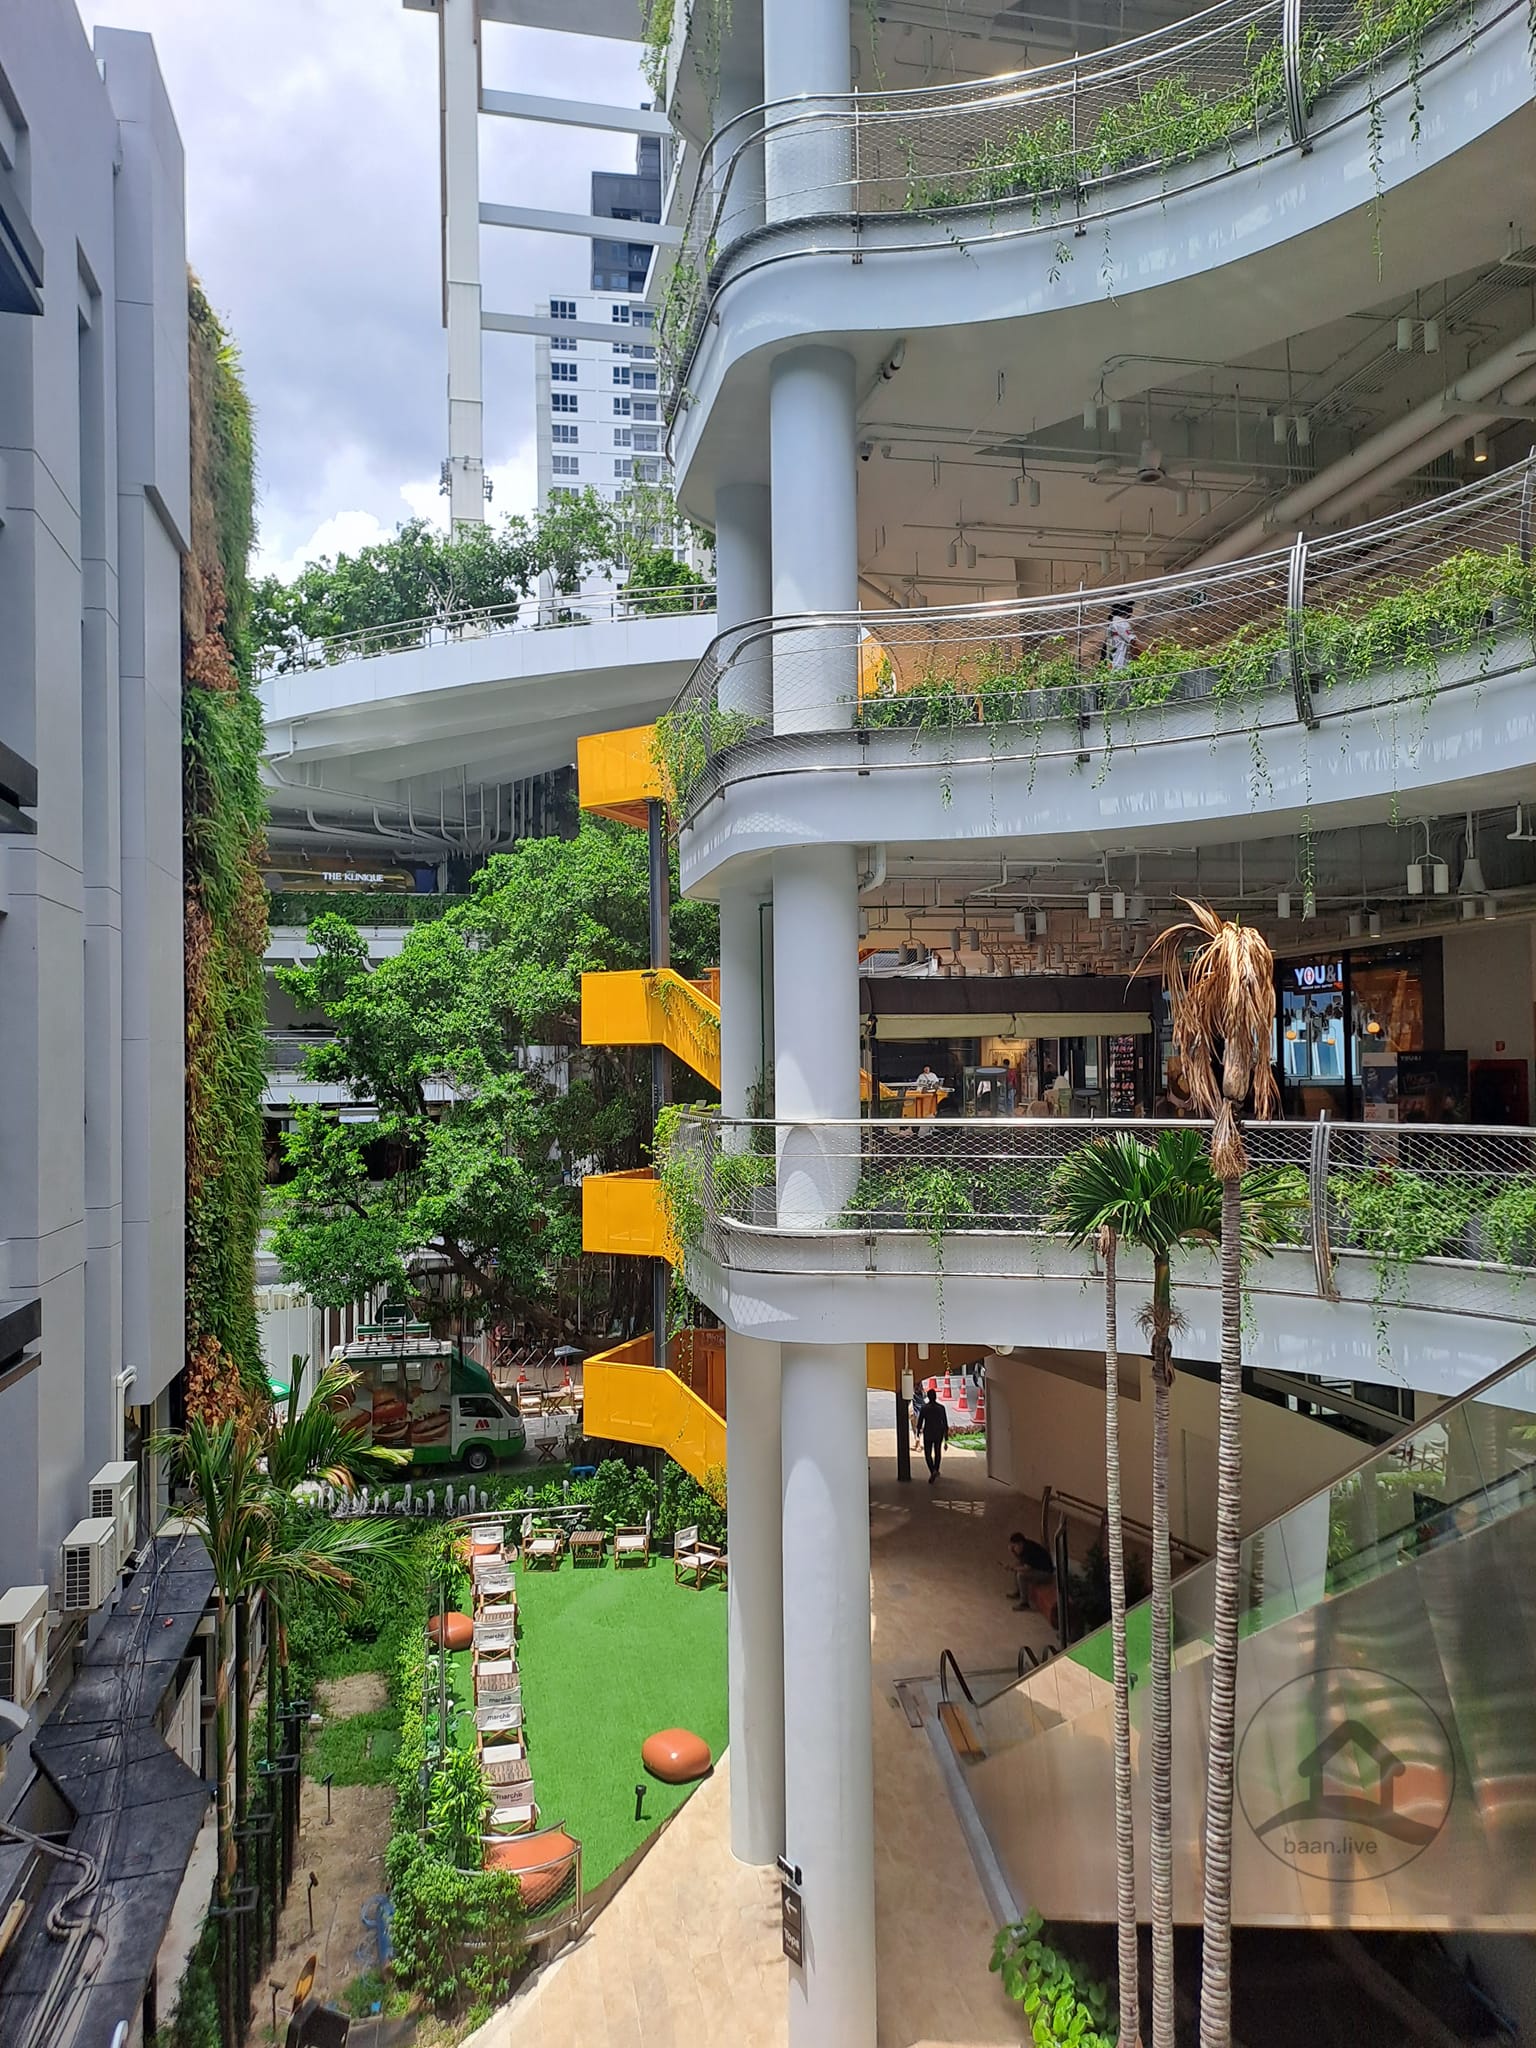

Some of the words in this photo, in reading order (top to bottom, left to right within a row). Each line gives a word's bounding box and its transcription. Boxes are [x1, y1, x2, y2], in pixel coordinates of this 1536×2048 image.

[321, 871, 342, 881] THE
[344, 872, 385, 883] KLINIQUE
[783, 1926, 801, 1951] Tops
